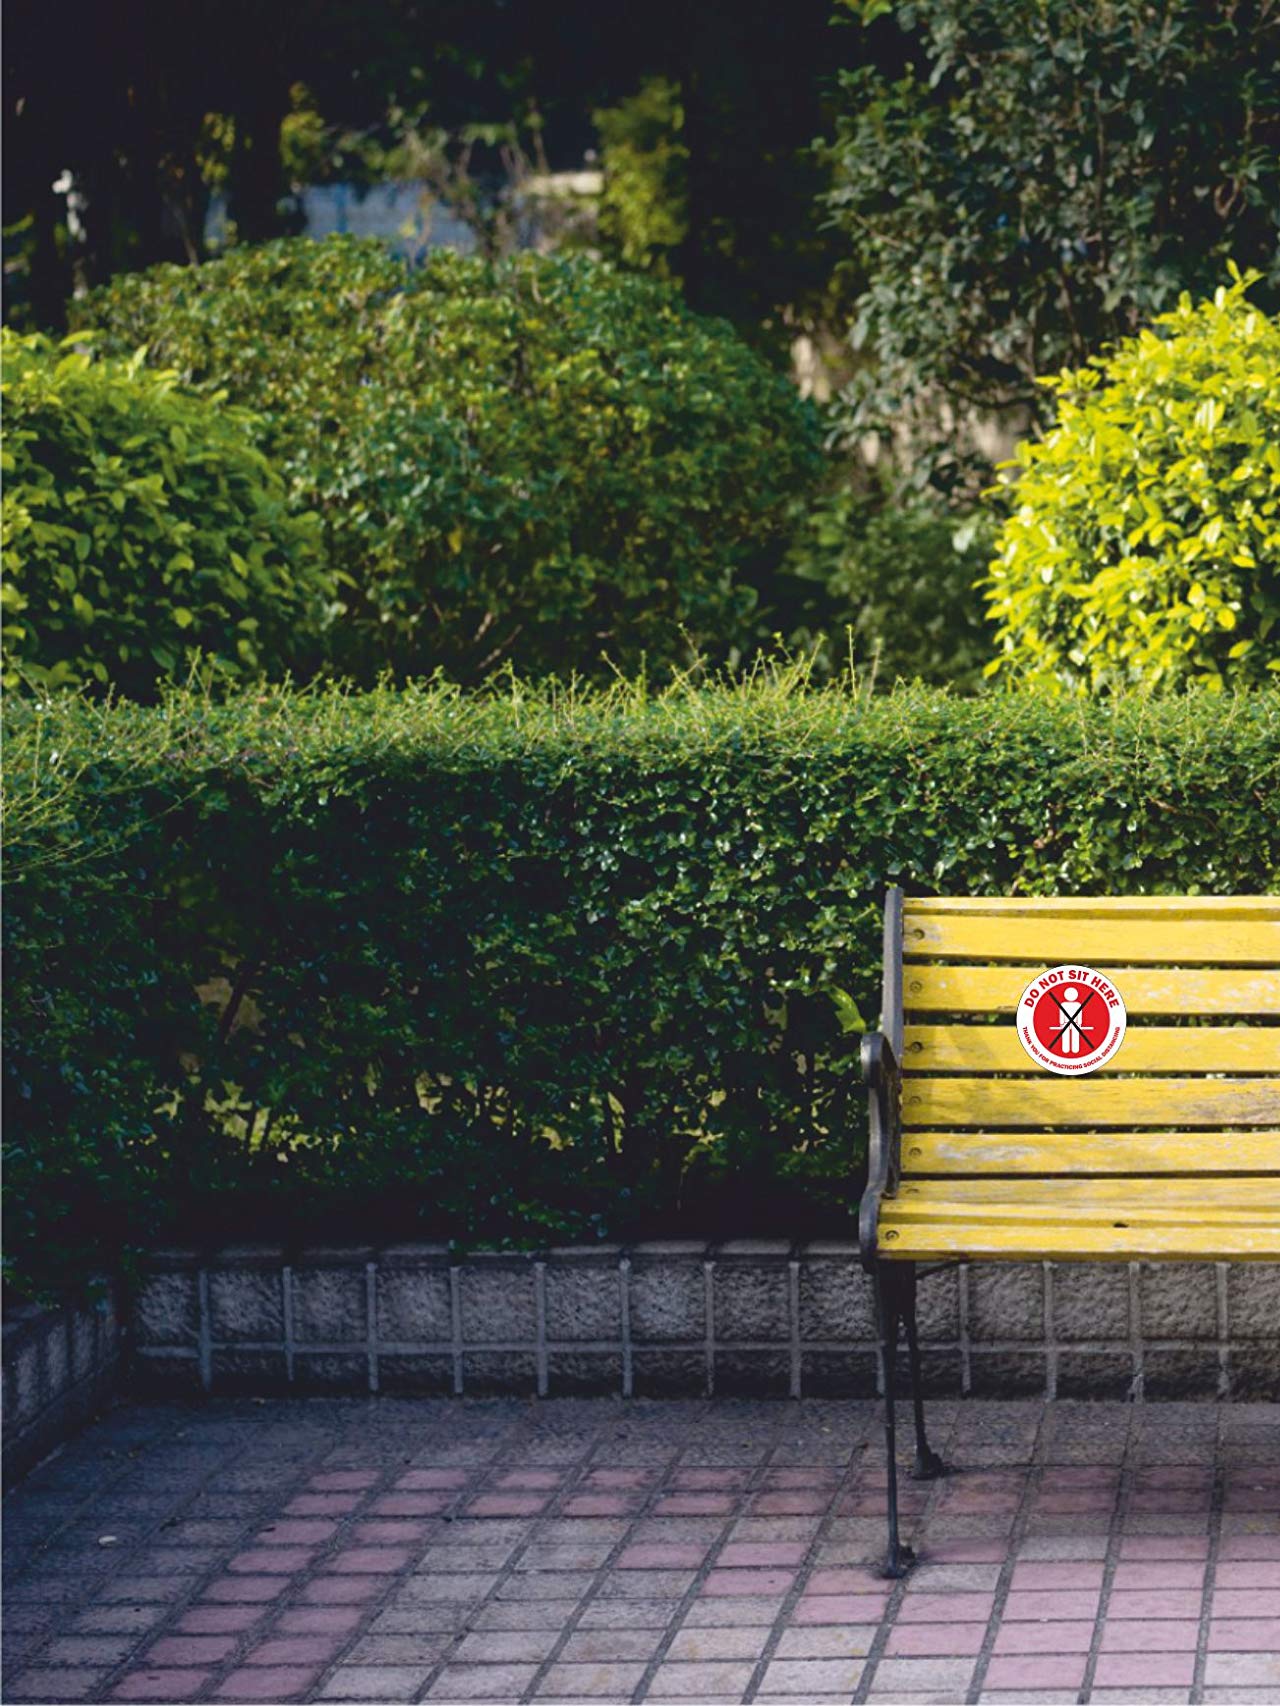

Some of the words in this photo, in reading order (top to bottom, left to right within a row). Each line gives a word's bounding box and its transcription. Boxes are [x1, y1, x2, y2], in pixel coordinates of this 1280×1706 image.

[1024, 989, 1039, 1008] DO
[1038, 970, 1064, 989] NOT
[1068, 969, 1089, 981] SIT
[1090, 976, 1119, 1008] HERE
[1022, 1026, 1032, 1045] THANK
[1030, 1044, 1040, 1055] YOU
[1039, 1053, 1050, 1064] FOR
[1049, 1060, 1083, 1070] PRACTICING
[1083, 1056, 1103, 1068] SOCIAL
[1101, 1026, 1120, 1057] DISTANCING
